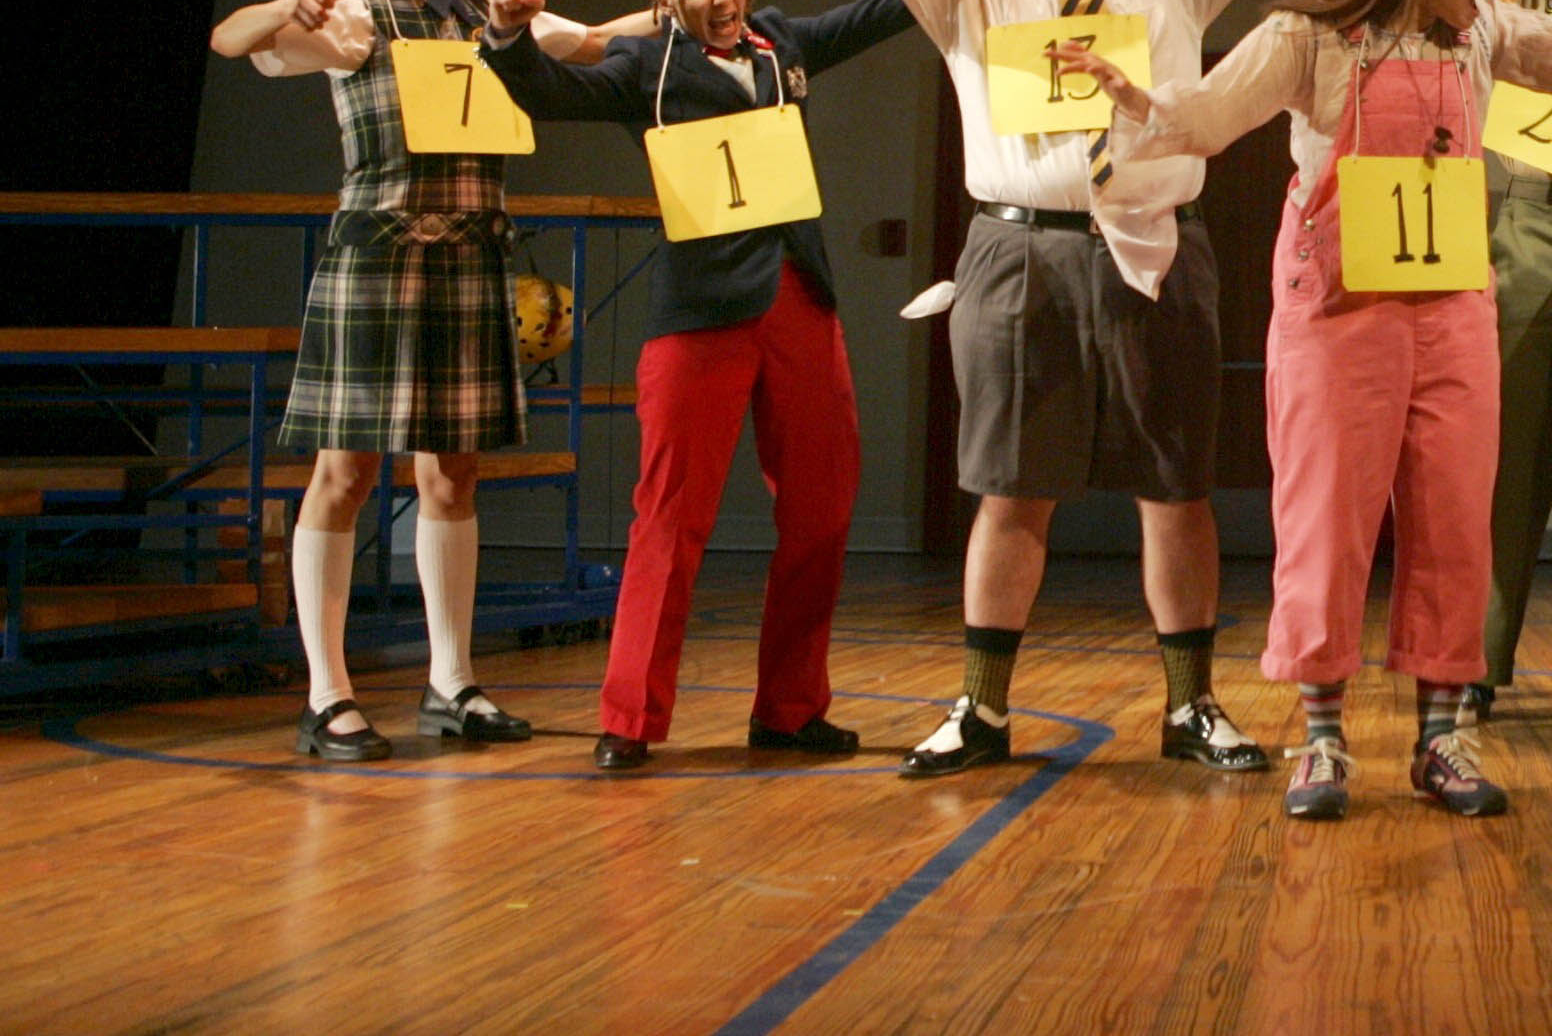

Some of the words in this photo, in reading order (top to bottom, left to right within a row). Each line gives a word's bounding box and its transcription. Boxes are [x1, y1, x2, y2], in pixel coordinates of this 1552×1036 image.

[443, 63, 473, 127] 7
[1044, 34, 1100, 104] 13
[717, 138, 747, 210] 1
[1391, 181, 1441, 264] 11
